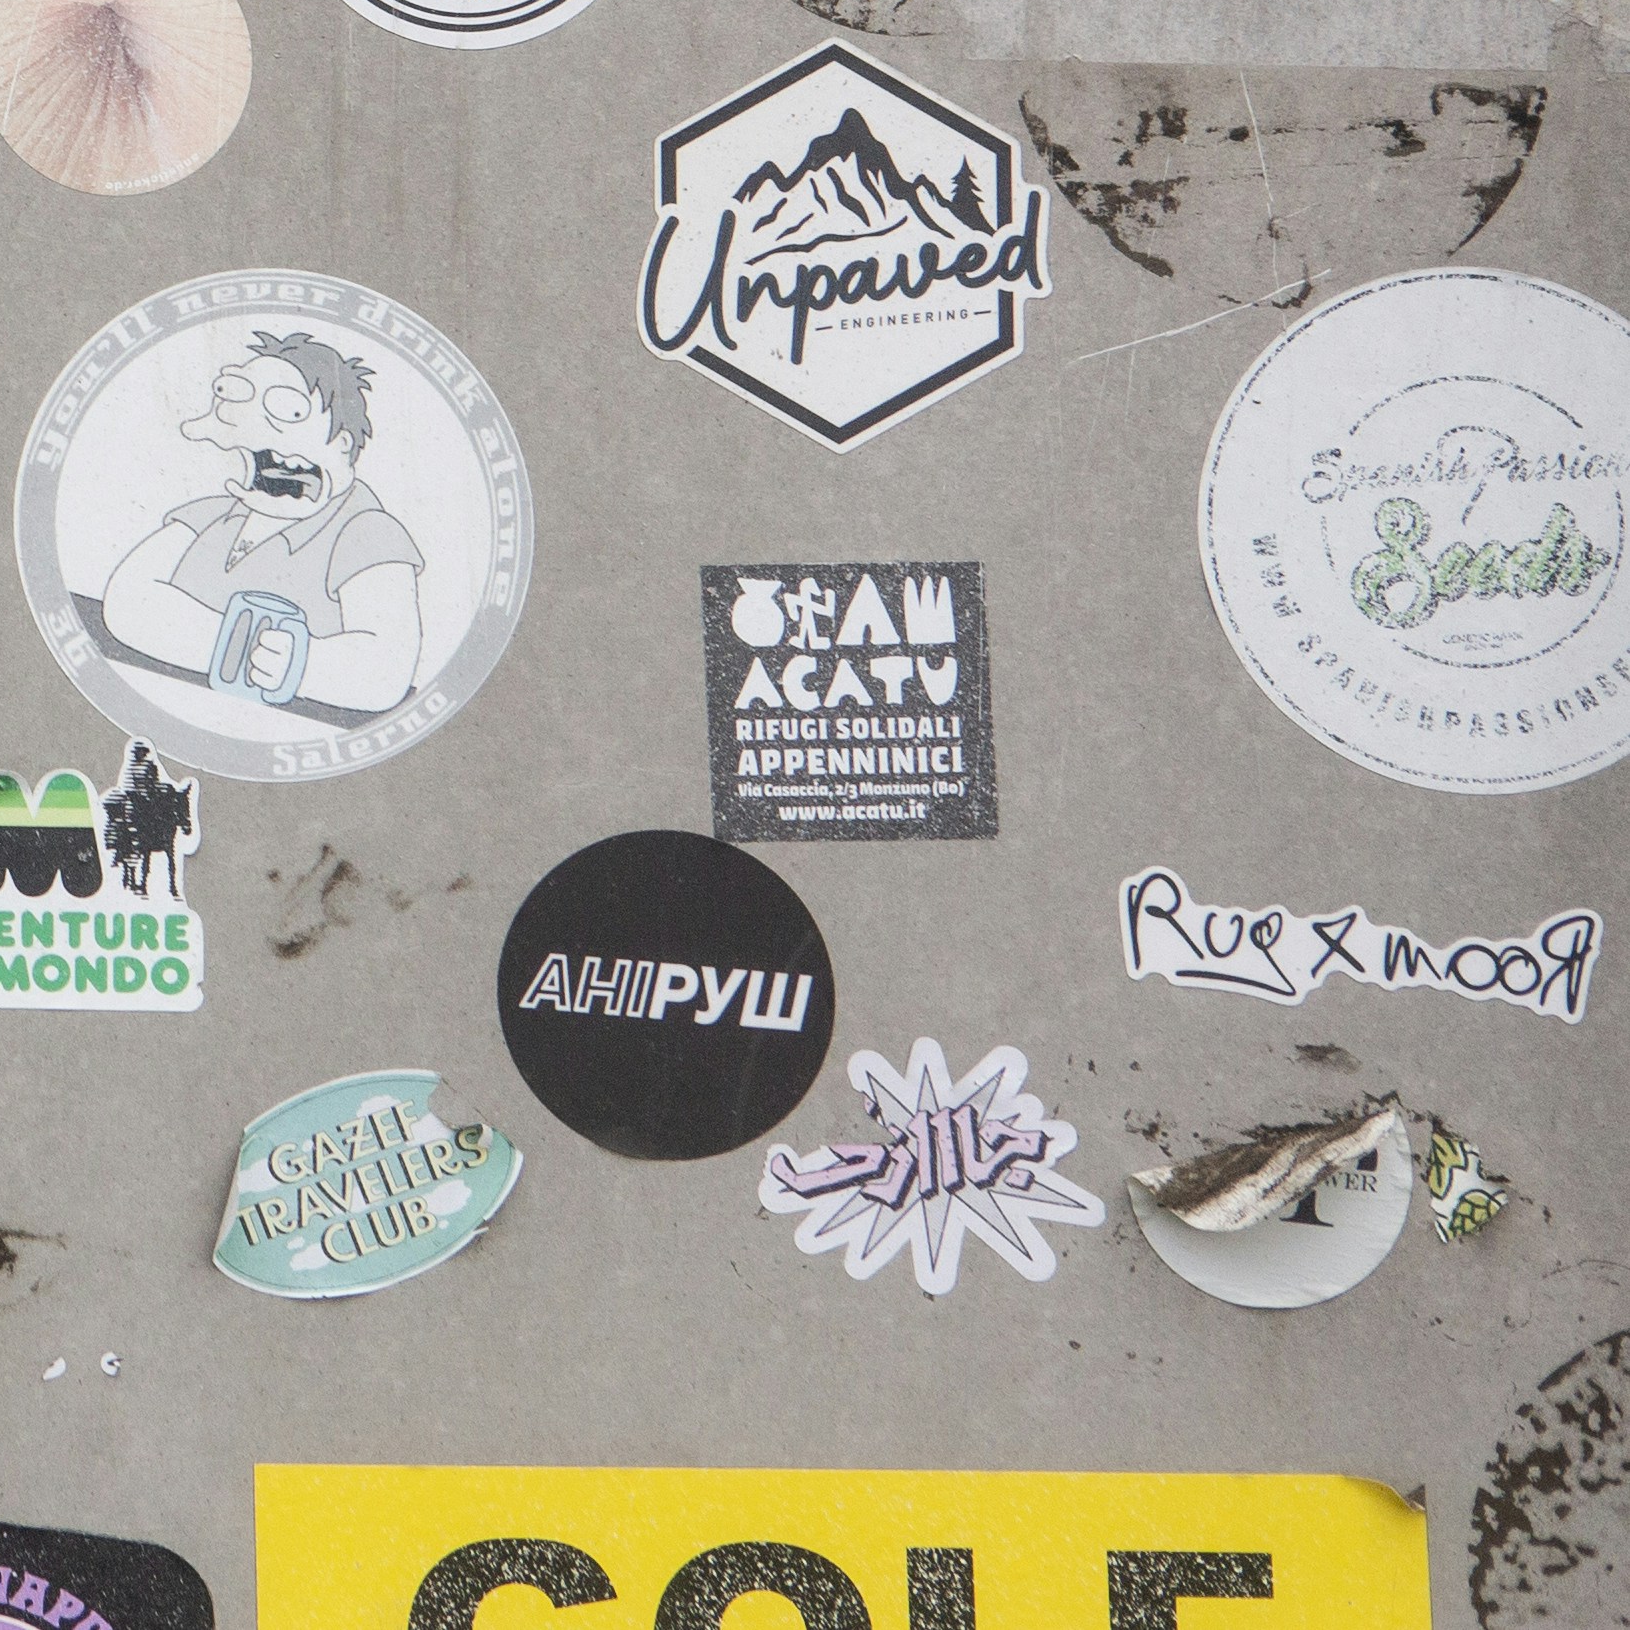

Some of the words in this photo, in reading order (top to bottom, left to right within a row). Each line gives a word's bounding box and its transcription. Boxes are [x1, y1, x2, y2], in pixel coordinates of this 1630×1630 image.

[641, 189, 1044, 365] Unpaved
[840, 308, 970, 331] ENGINEERING
[358, 297, 487, 415] drink
[735, 655, 958, 711] ACATU
[273, 690, 452, 778] Salerno
[735, 718, 828, 742] RIFUGI
[836, 716, 961, 740] SOLIDALI
[737, 746, 963, 777] APPENNINICI
[738, 783, 761, 798] Via
[779, 799, 926, 821] www.acatu.it
[236, 1126, 490, 1249] TRAVELERS
[320, 1196, 438, 1265] CLUB
